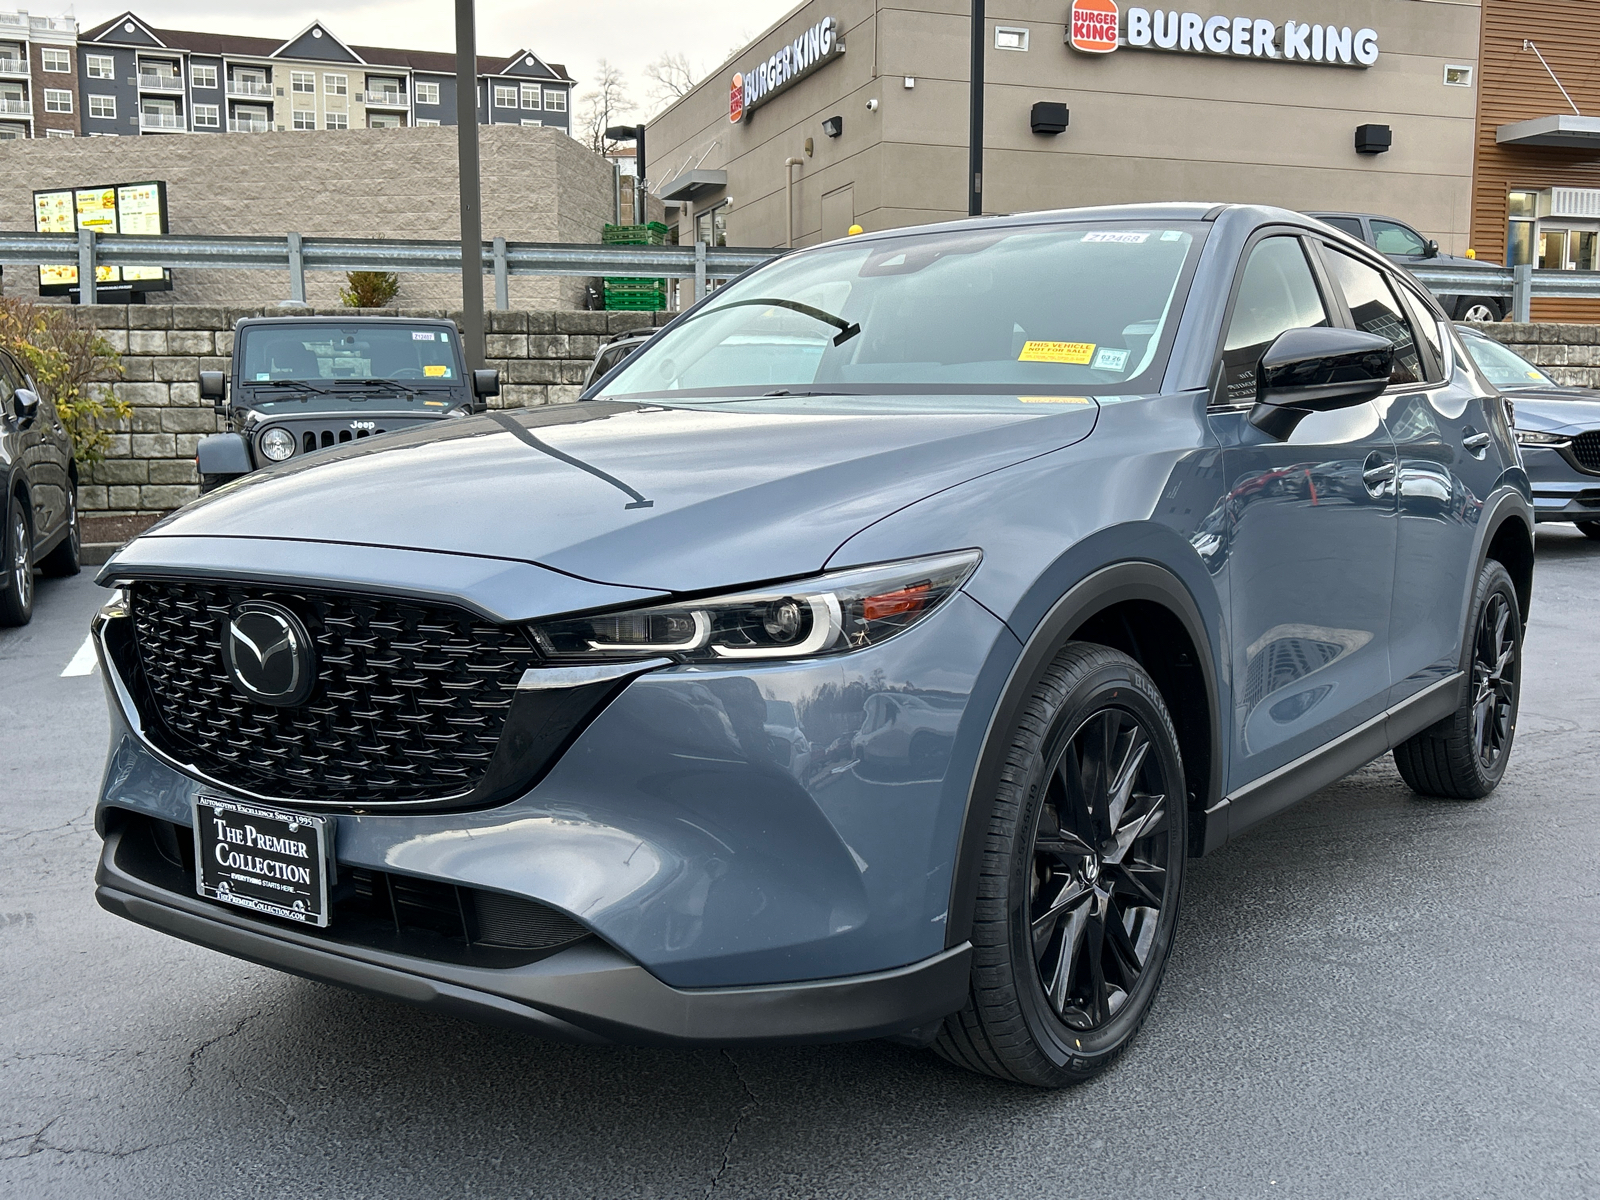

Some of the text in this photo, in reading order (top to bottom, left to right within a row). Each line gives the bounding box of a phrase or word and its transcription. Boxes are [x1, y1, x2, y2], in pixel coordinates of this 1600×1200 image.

[1073, 10, 1117, 25] BURGER
[1073, 22, 1117, 42] KING
[1127, 7, 1379, 65] BURGER KING
[744, 45, 791, 107] BURGER
[793, 16, 832, 75] KING
[350, 420, 375, 430] Jeep
[295, 815, 313, 827] 1995
[213, 818, 309, 858] THE PREMIER
[215, 842, 310, 885] COLLECTION
[230, 872, 261, 886] EVERYTHING
[261, 879, 281, 891] STARTS
